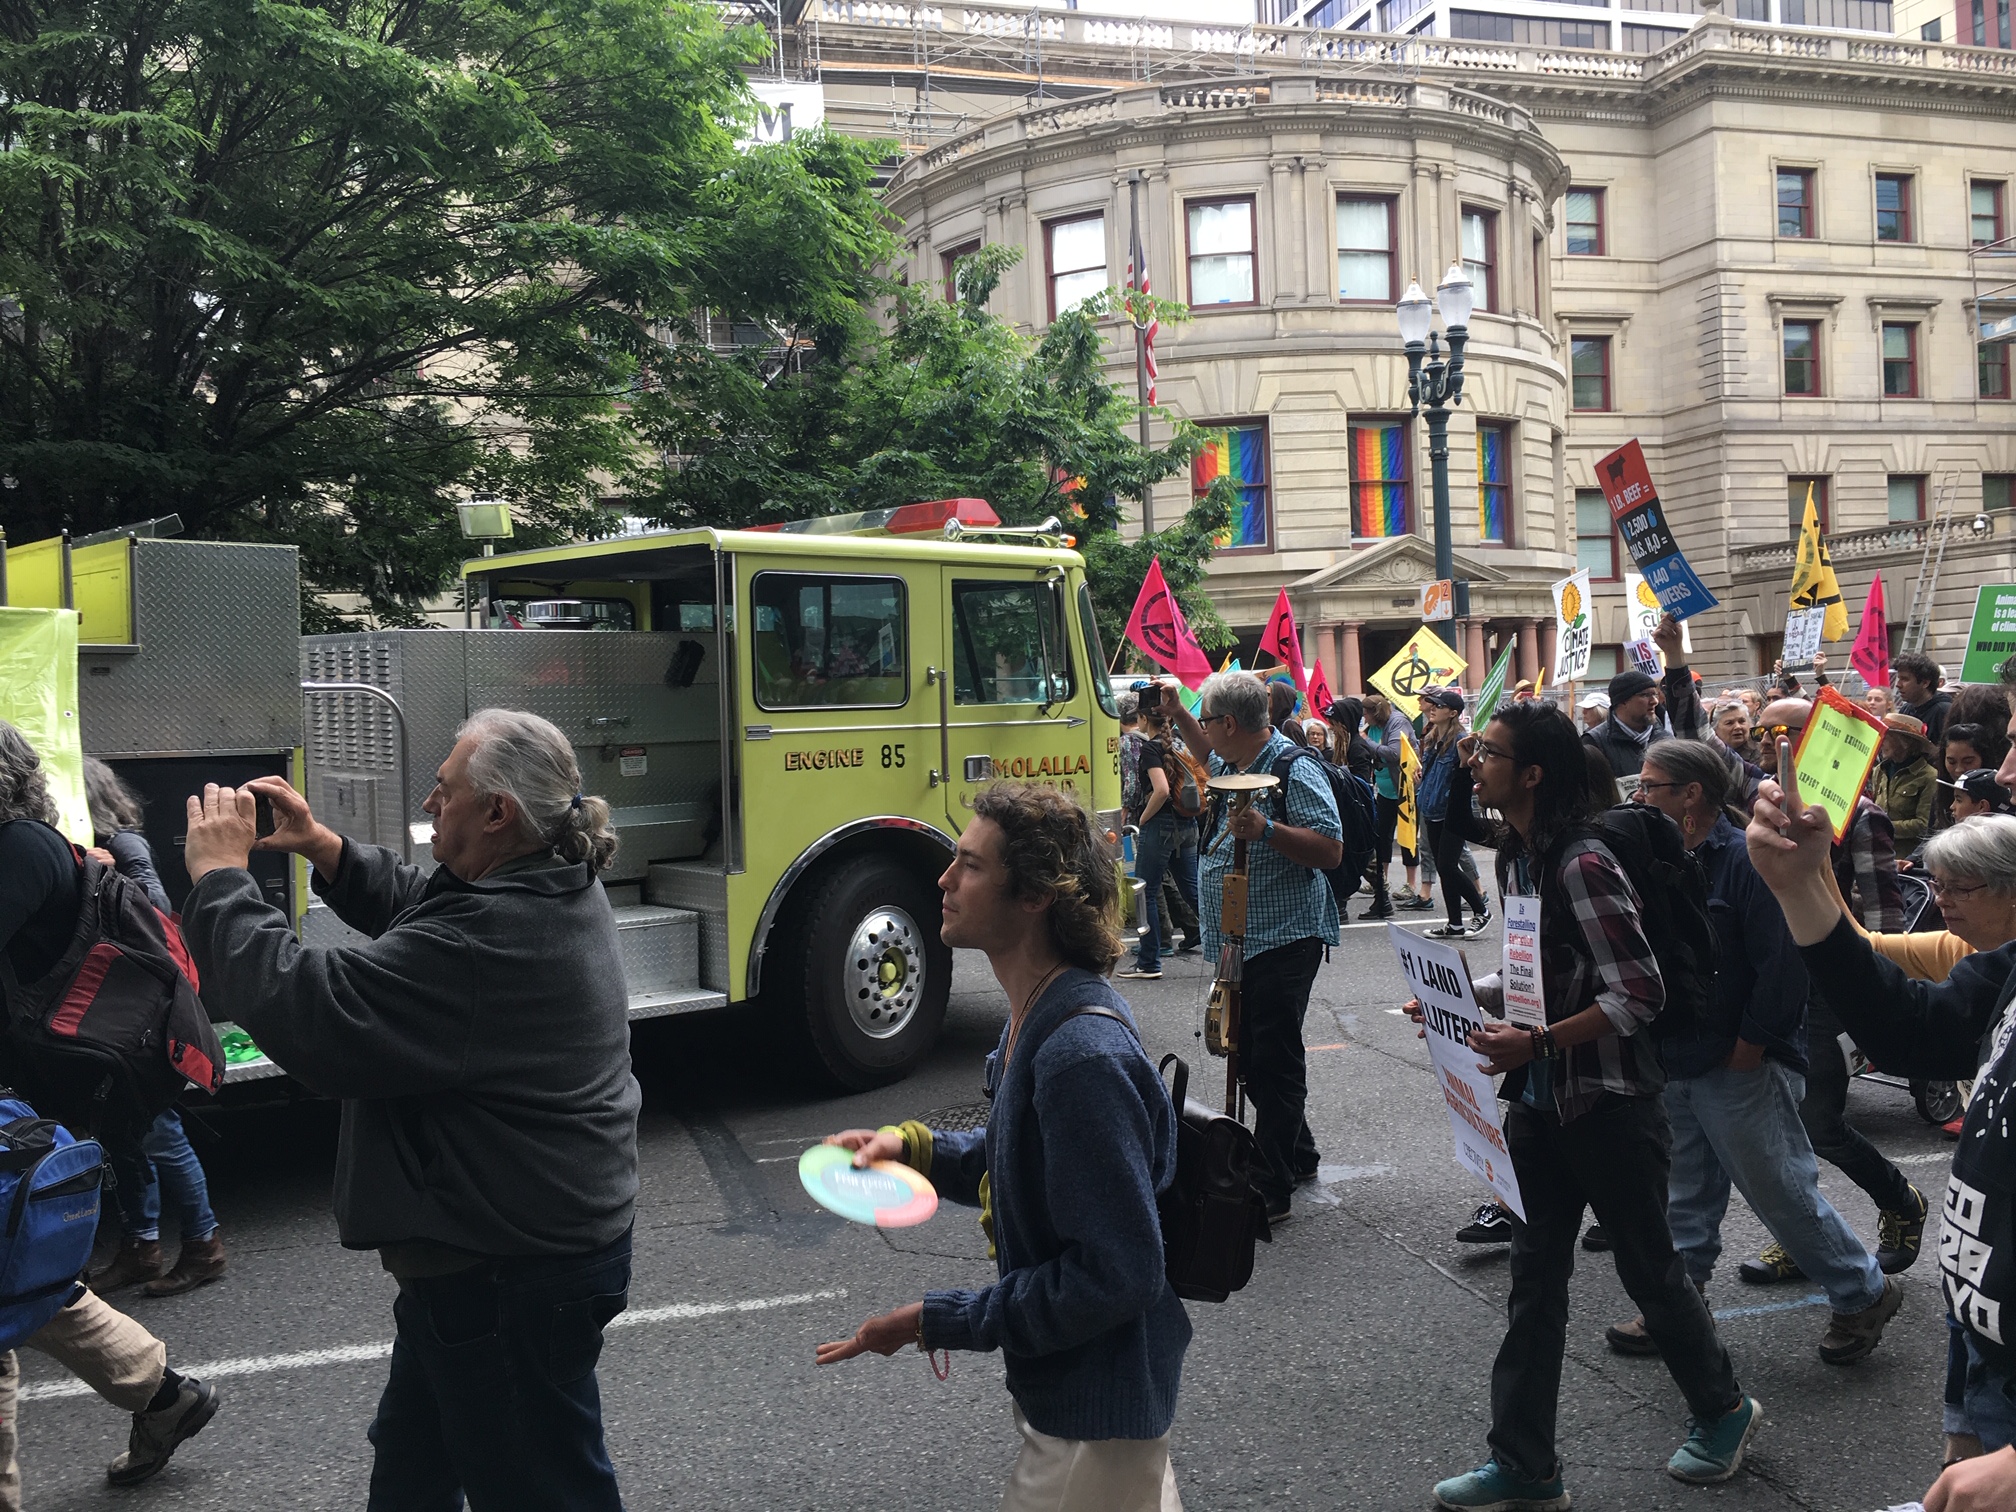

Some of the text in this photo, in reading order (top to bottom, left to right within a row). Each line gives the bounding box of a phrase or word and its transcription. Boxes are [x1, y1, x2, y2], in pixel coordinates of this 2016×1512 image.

[1622, 482, 1642, 505] BEEF
[1627, 513, 1649, 538] 2,500
[1442, 583, 1449, 598] 2
[1636, 642, 1652, 661] IS
[1976, 641, 1992, 652] WHO
[1993, 641, 2006, 652] DID
[785, 744, 906, 771] ENGINE 85
[993, 754, 1090, 778] MOLALLA
[1798, 771, 1820, 790] EXPECT
[1519, 903, 1525, 914] Is
[1507, 917, 1536, 932] Forestalling
[1509, 948, 1533, 963] Rebellion
[1417, 955, 1463, 999] LAND
[1510, 963, 1534, 978] The Final
[1509, 979, 1535, 994] Solution?
[1441, 1064, 1482, 1113] ANIMAL
